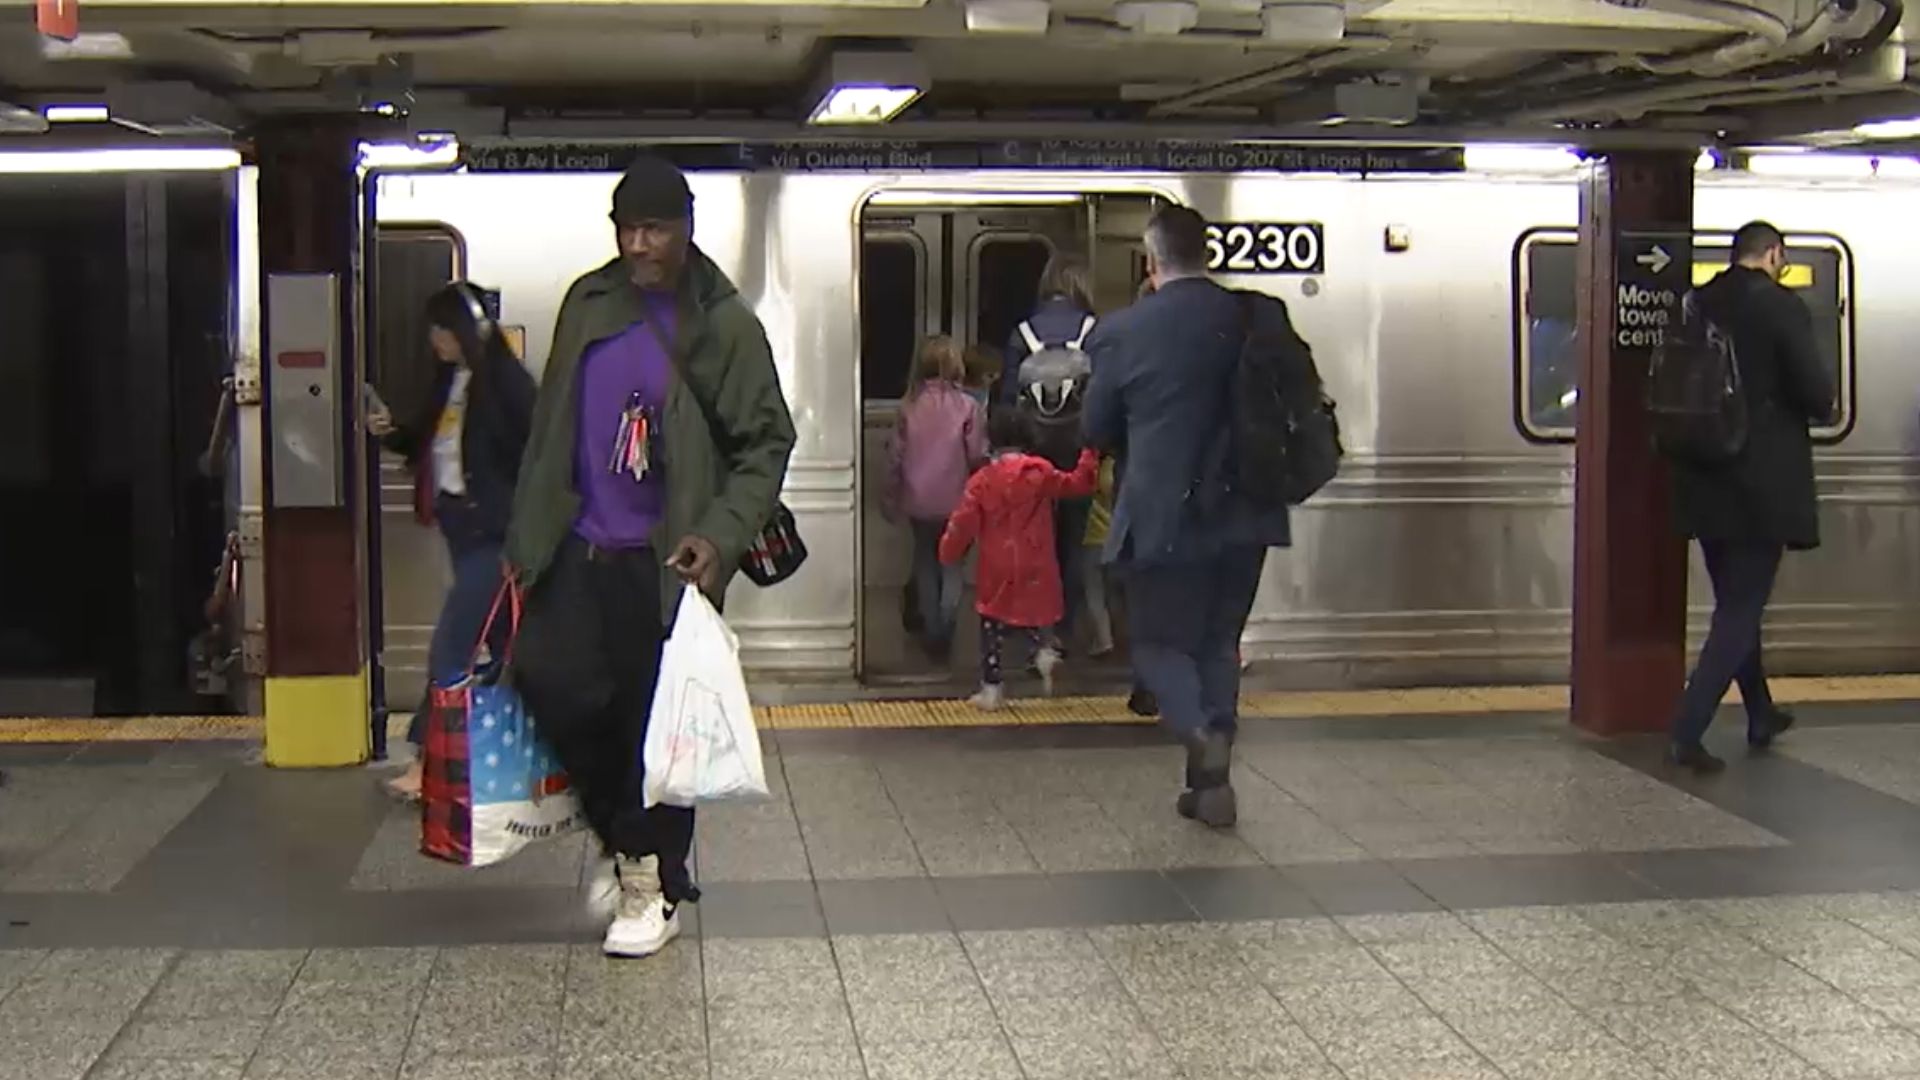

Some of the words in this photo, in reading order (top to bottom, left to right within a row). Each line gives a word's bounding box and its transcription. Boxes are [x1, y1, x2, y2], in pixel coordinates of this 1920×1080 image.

[470, 149, 499, 169] via
[525, 152, 548, 169] Av
[553, 151, 609, 169] Local
[805, 151, 884, 168] Queens
[888, 151, 932, 167] Blvd
[1167, 151, 1213, 168] local
[1218, 151, 1238, 168] to
[1241, 150, 1279, 168] 207
[1205, 225, 1319, 270] 6230
[1617, 284, 1675, 306] Move
[1618, 307, 1669, 326] towa
[1618, 327, 1664, 346] cent
